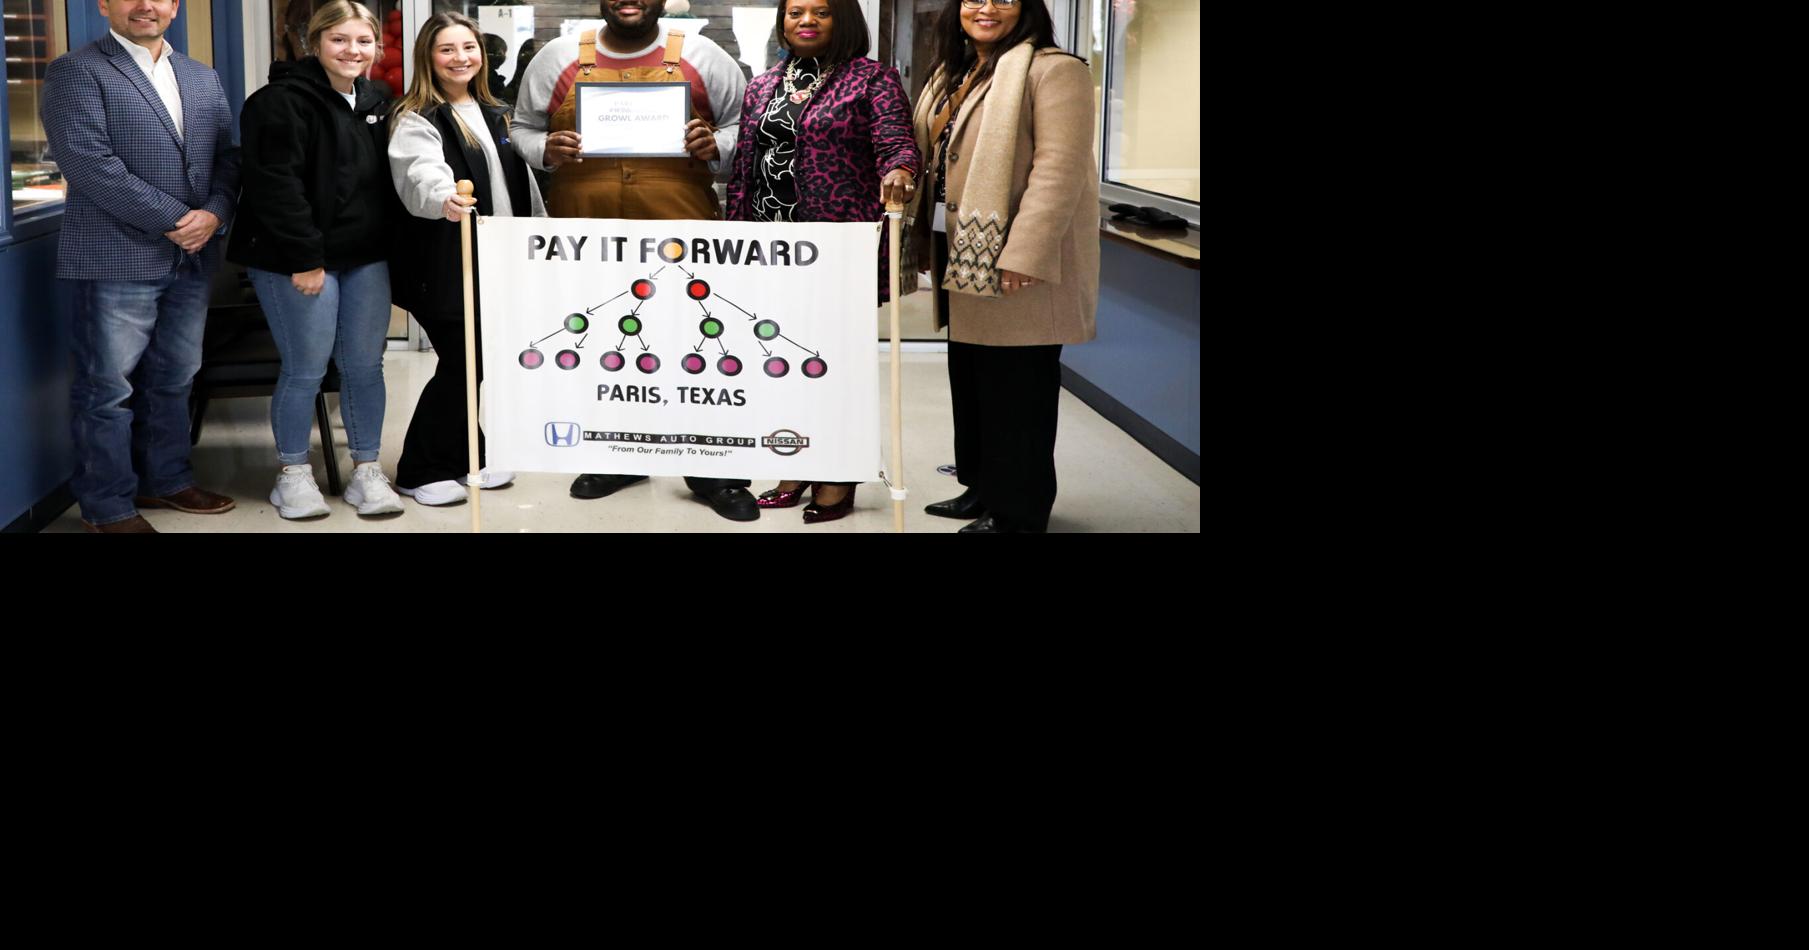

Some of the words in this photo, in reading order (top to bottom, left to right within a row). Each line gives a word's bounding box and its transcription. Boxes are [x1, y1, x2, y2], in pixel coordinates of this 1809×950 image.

[598, 114, 631, 122] GROWL
[527, 235, 588, 261] PAY
[601, 236, 628, 262] IT
[639, 237, 819, 267] FORWARD
[597, 384, 669, 406] PARIS,
[677, 386, 747, 407] TEXAS
[584, 431, 652, 442] MATHEWS
[660, 434, 697, 443] AUTO
[705, 436, 755, 446] GROUP
[766, 437, 804, 446] NISSAN
[637, 446, 653, 454] Our
[655, 447, 684, 456] Family
[687, 447, 697, 455] To
